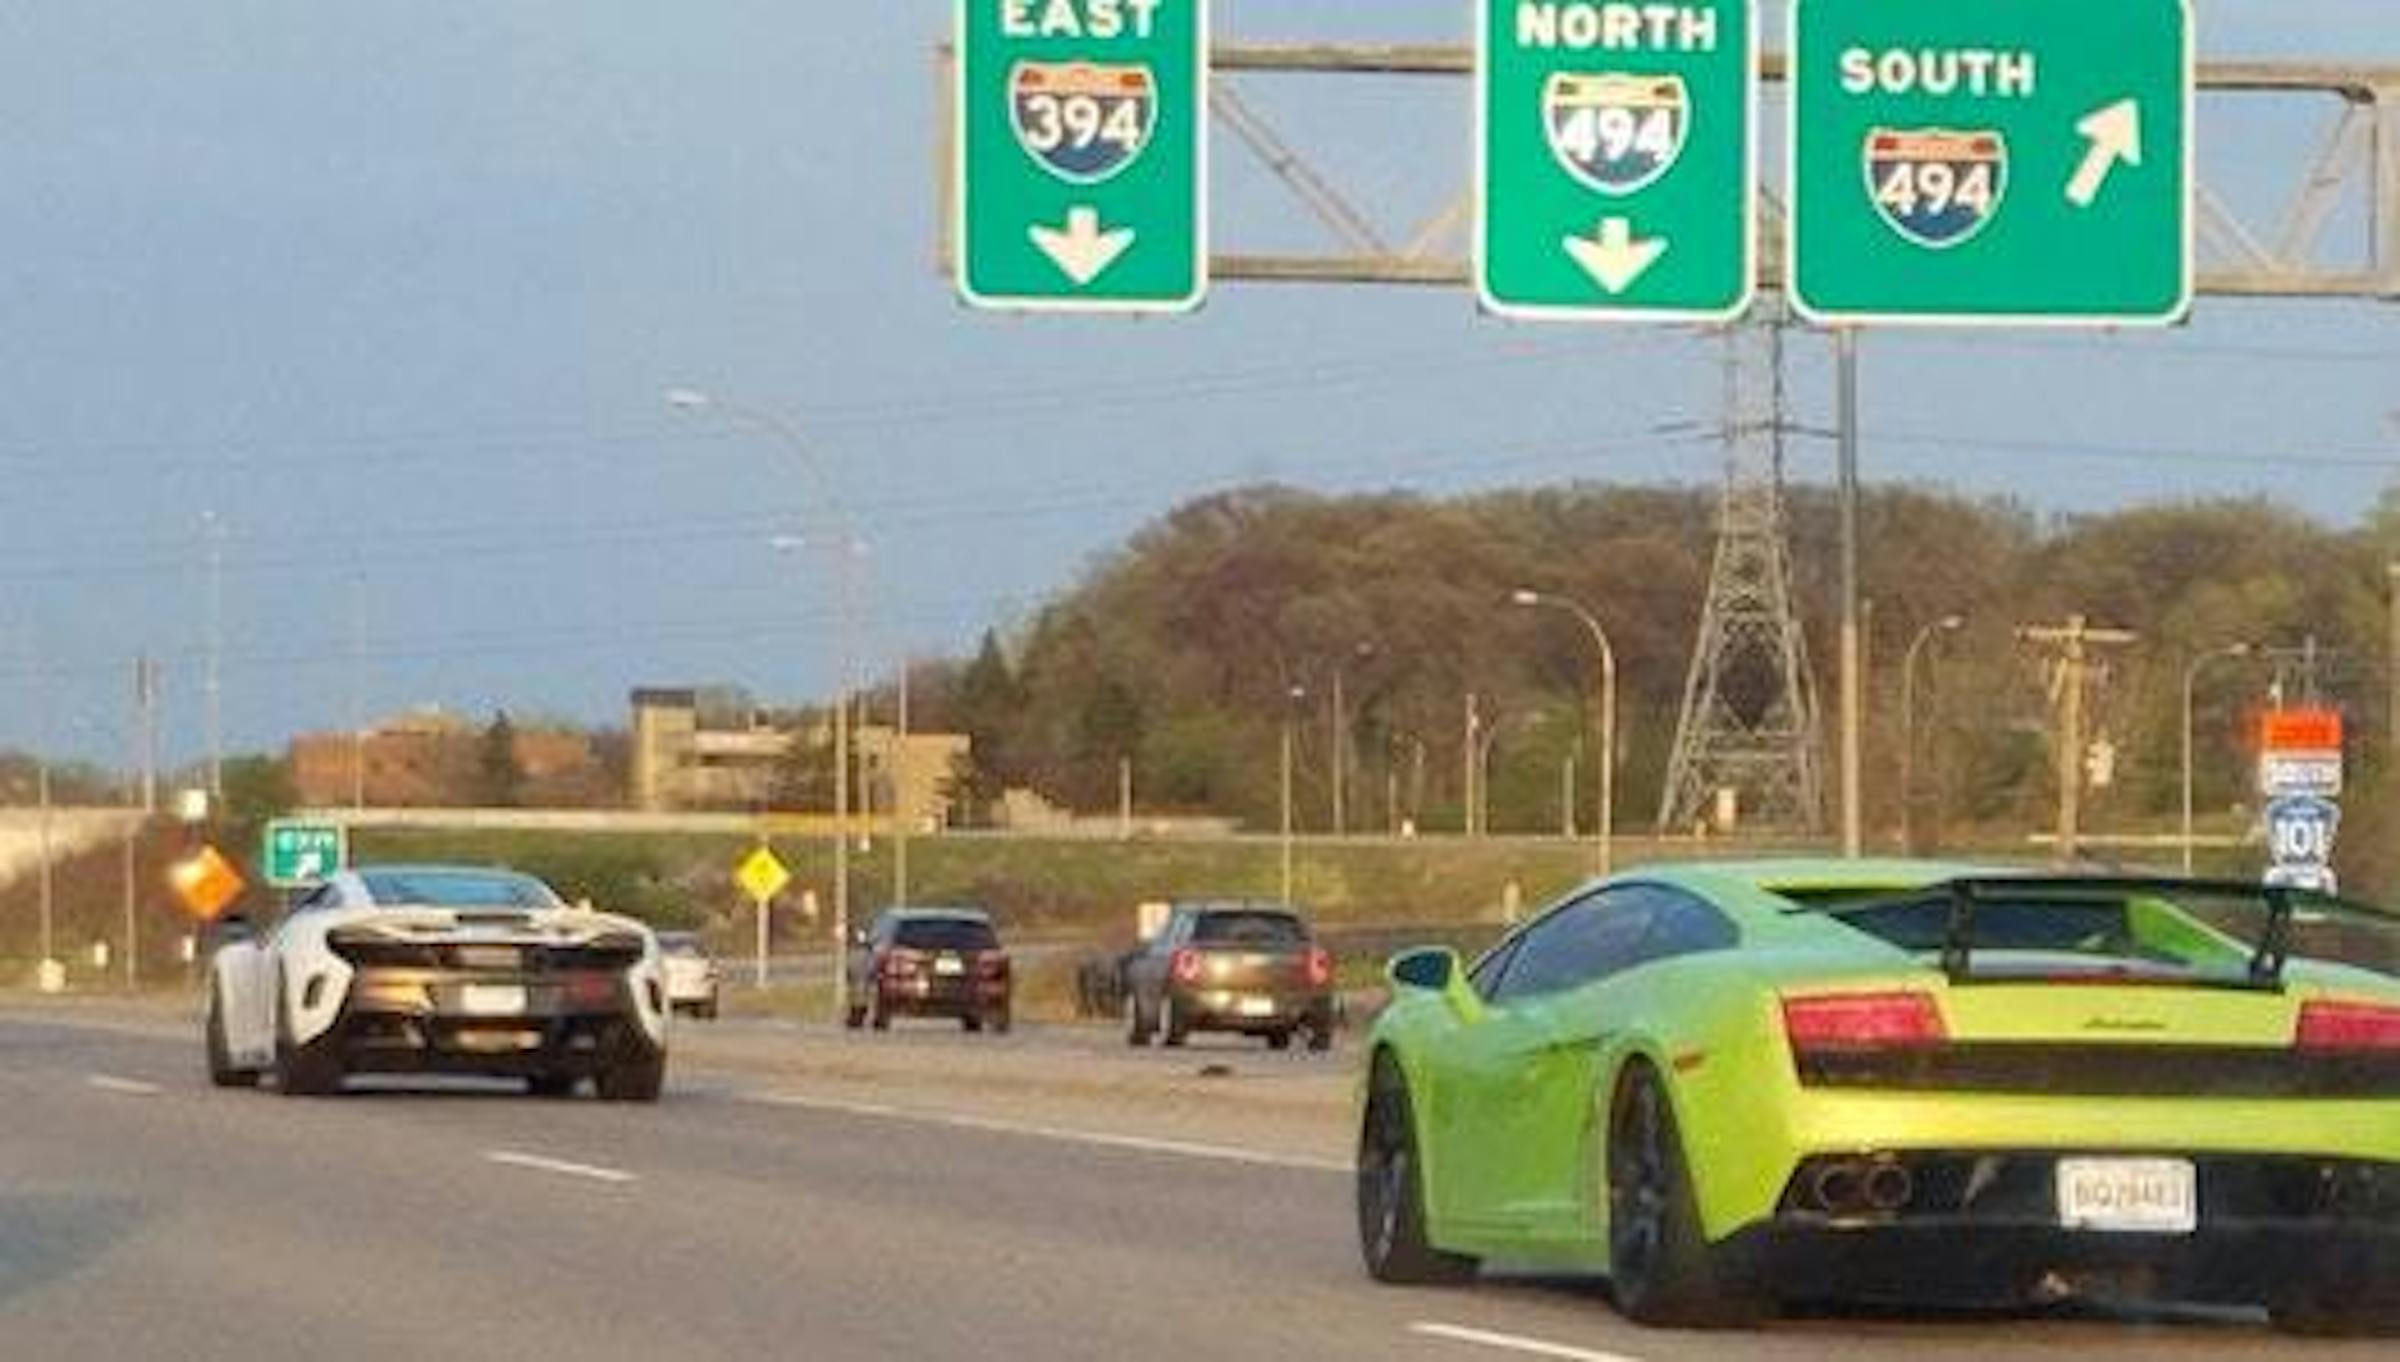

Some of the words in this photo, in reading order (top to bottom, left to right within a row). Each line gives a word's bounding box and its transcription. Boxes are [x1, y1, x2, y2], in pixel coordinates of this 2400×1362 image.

[1002, 0, 1162, 38] EAST
[1516, 3, 1717, 50] NORTH
[1840, 48, 2035, 96] SOUTH
[1026, 96, 1140, 150] 394
[1561, 107, 1674, 162] 494
[1876, 162, 1992, 216] 494
[2274, 819, 2327, 855] 101
